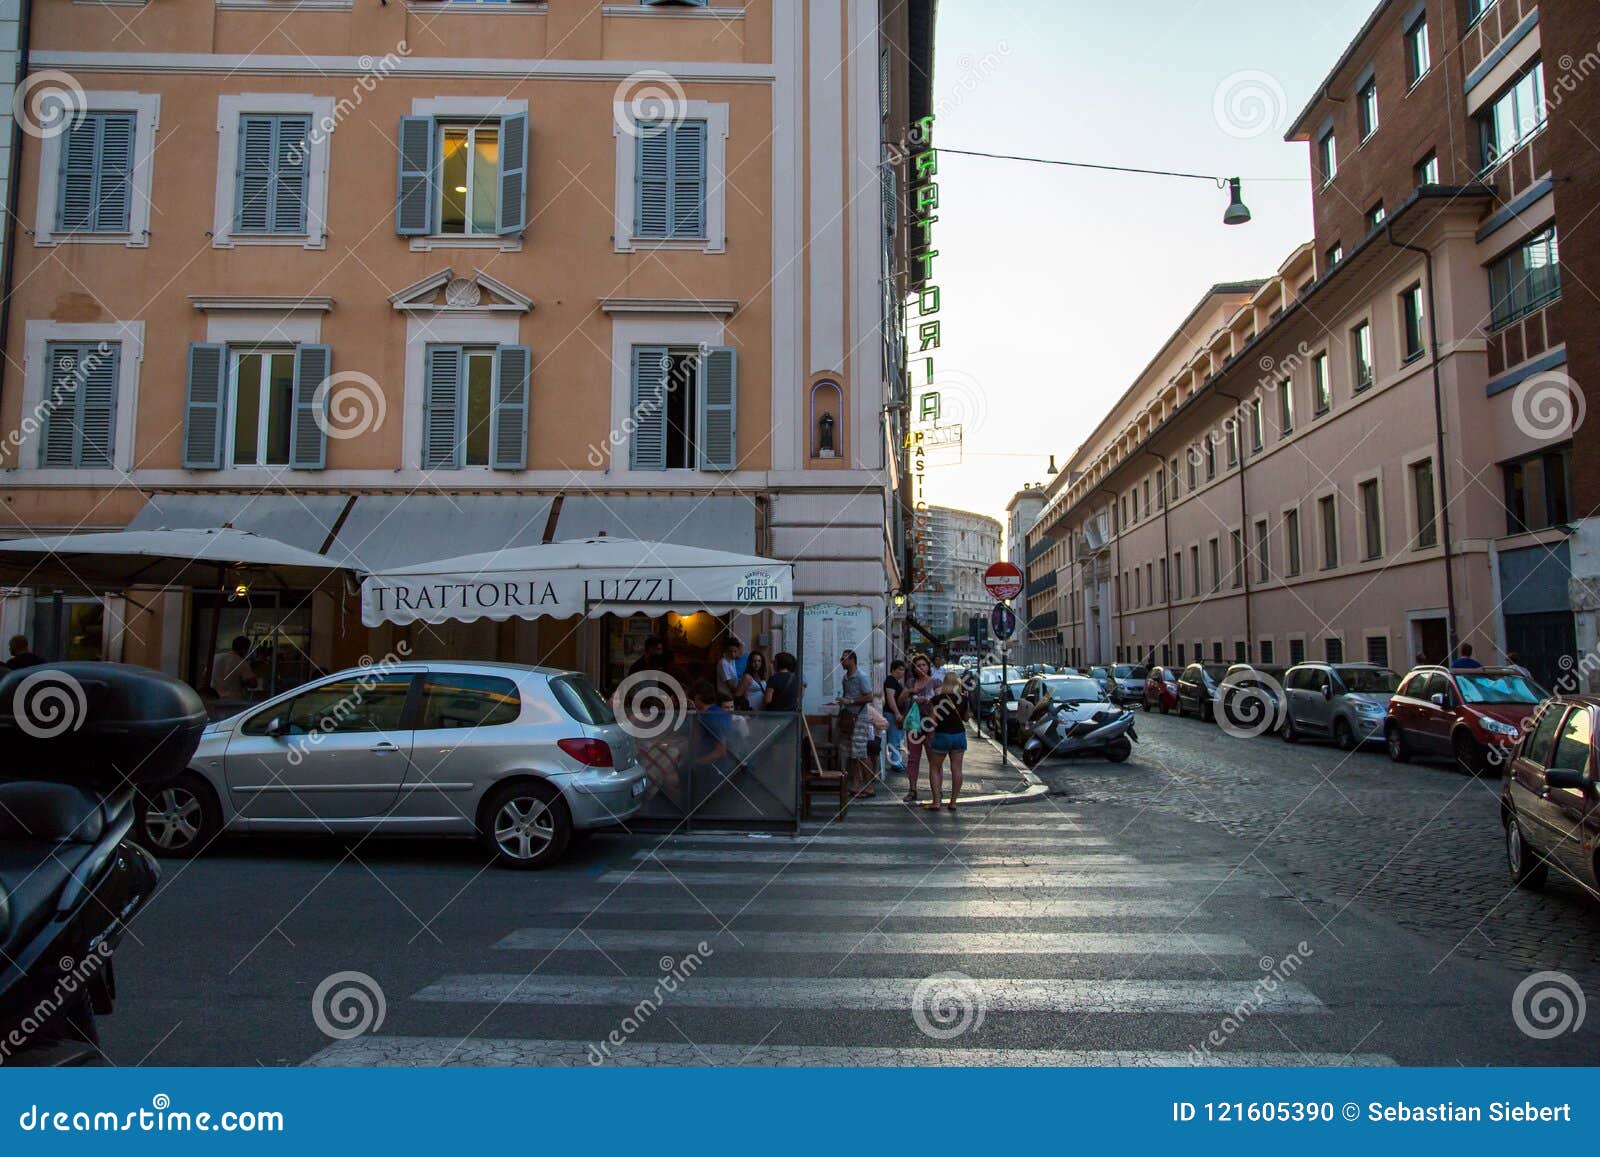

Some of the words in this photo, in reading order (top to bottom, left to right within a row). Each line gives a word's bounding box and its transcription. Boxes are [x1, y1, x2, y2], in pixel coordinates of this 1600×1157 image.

[372, 582, 560, 611] TRATTORIA
[584, 578, 674, 601] LUZZI
[737, 586, 777, 600] PORETTI
